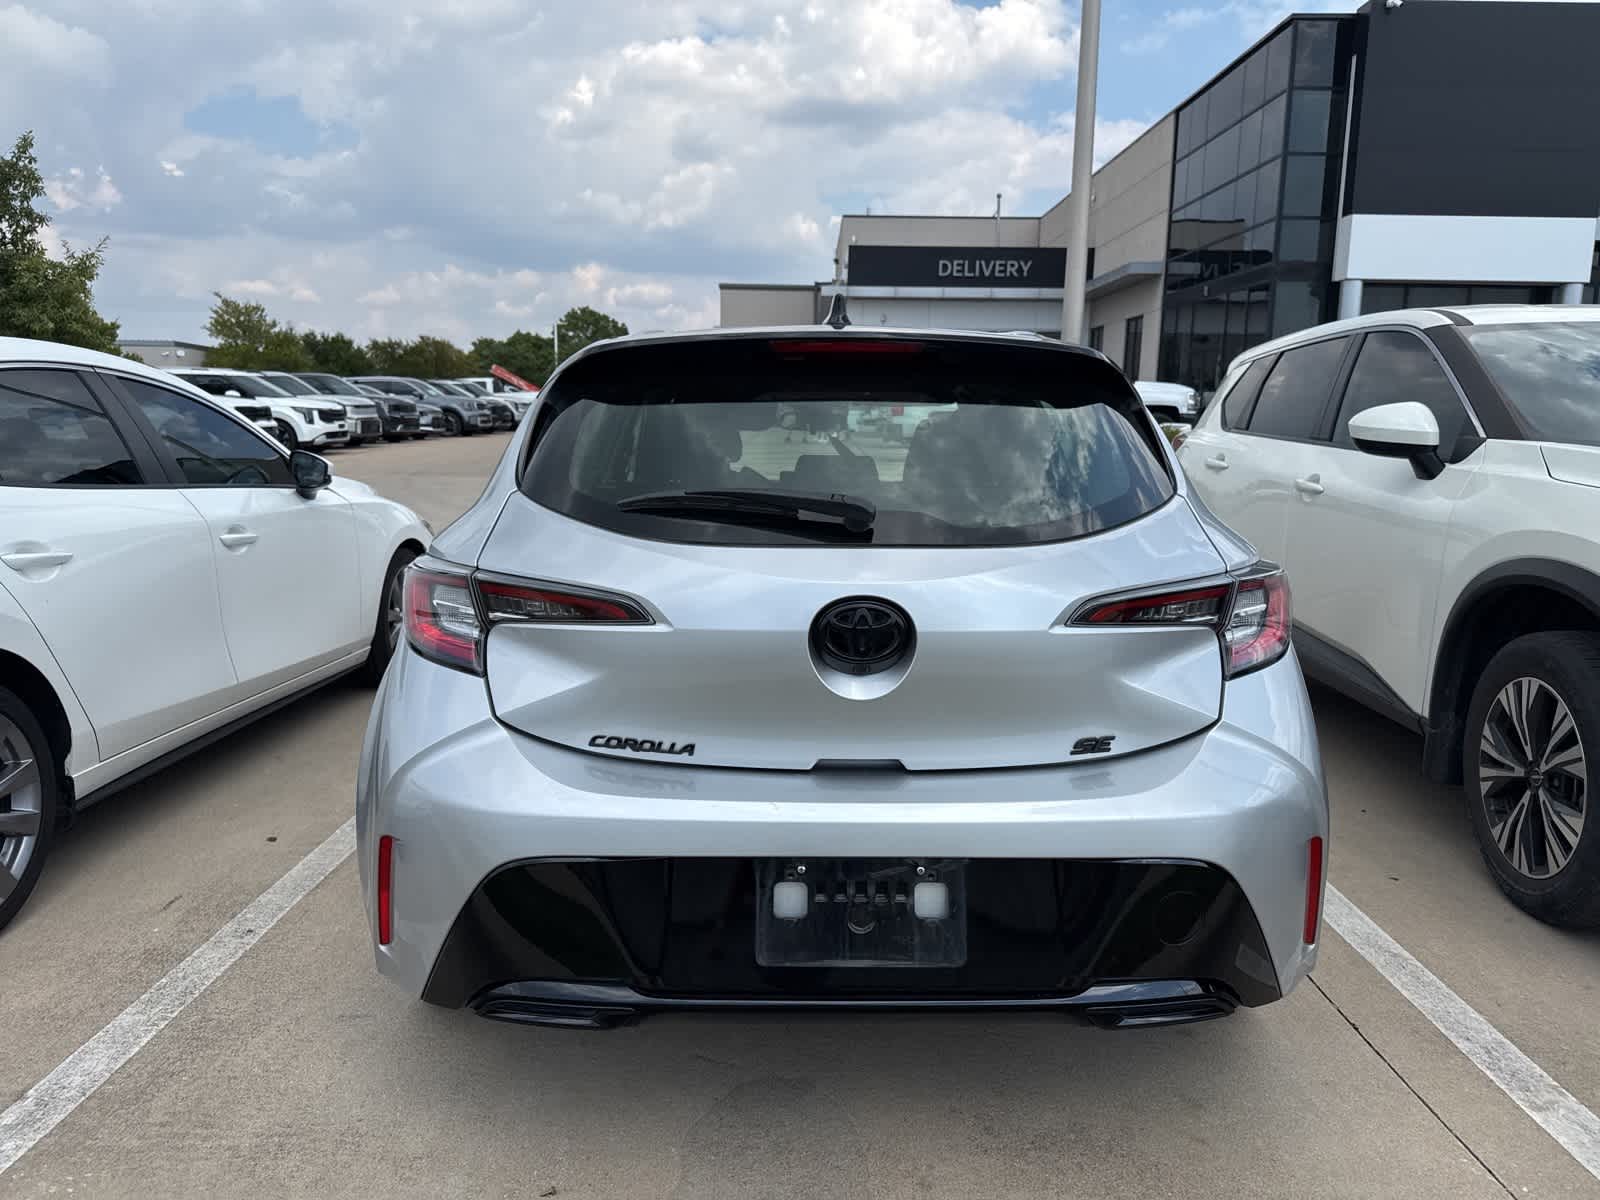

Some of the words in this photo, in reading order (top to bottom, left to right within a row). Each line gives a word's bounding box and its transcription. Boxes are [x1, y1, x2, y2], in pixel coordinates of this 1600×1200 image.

[938, 259, 1032, 277] DELIVERY
[588, 735, 696, 756] COROLLA
[1069, 735, 1116, 755] SE
